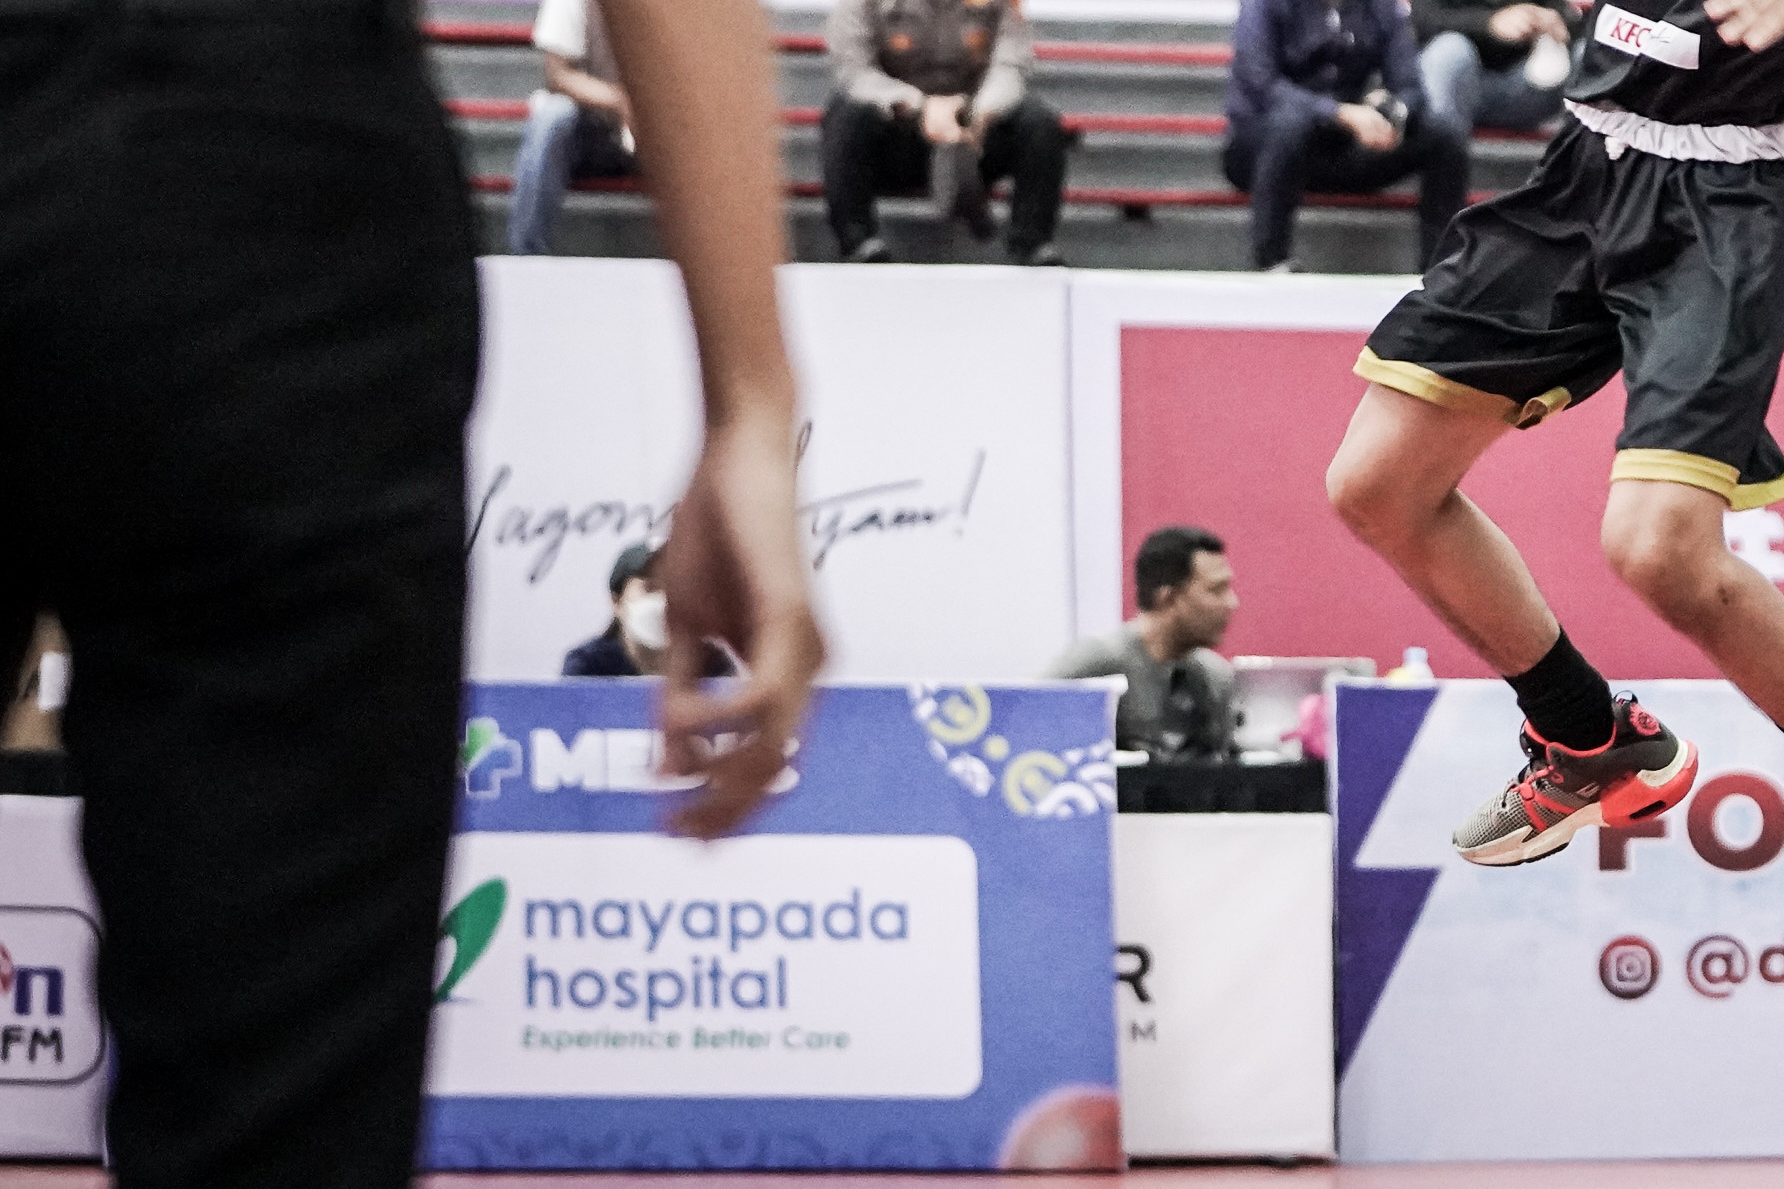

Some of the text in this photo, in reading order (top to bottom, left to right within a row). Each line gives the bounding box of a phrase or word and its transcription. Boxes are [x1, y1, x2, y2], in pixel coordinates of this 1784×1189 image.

[1608, 16, 1652, 49] KFC
[523, 889, 909, 953] mayapada
[523, 956, 788, 1022] hospital
[521, 1025, 852, 1052] Experience Better Care
